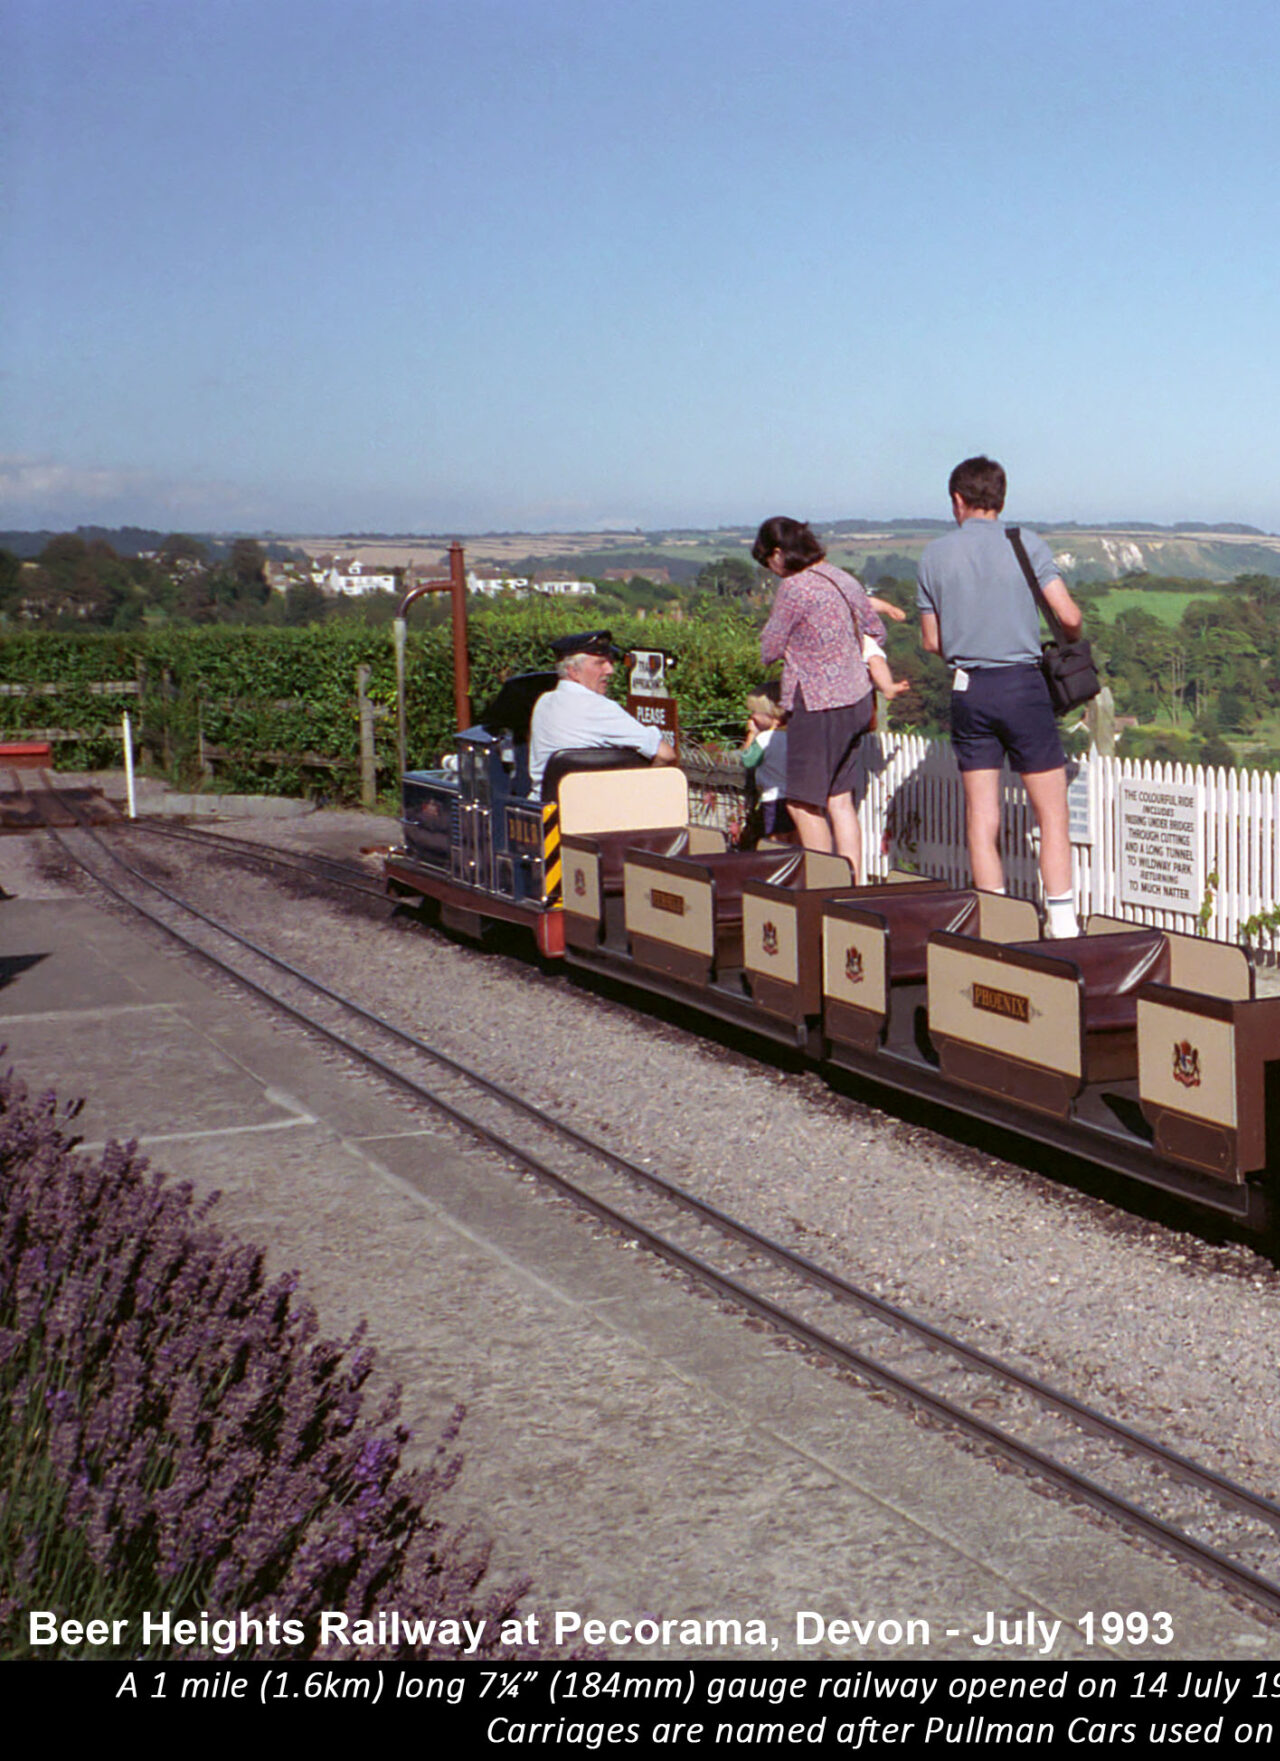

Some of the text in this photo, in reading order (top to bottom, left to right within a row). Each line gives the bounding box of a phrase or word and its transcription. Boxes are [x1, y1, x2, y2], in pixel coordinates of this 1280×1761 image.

[637, 706, 666, 725] PLEASE
[1124, 789, 1194, 808] THE COLOURFUL RIDE
[1129, 827, 1159, 842] THROUGH
[1125, 842, 1138, 853] AND
[1146, 845, 1163, 857] LONG
[1166, 847, 1194, 861] TUNNEL
[1128, 856, 1136, 866] TO
[1141, 870, 1178, 884] RETURNING
[1129, 880, 1138, 891] TO
[1141, 883, 1161, 894] MUCH
[976, 986, 1025, 1017] PHOENIX
